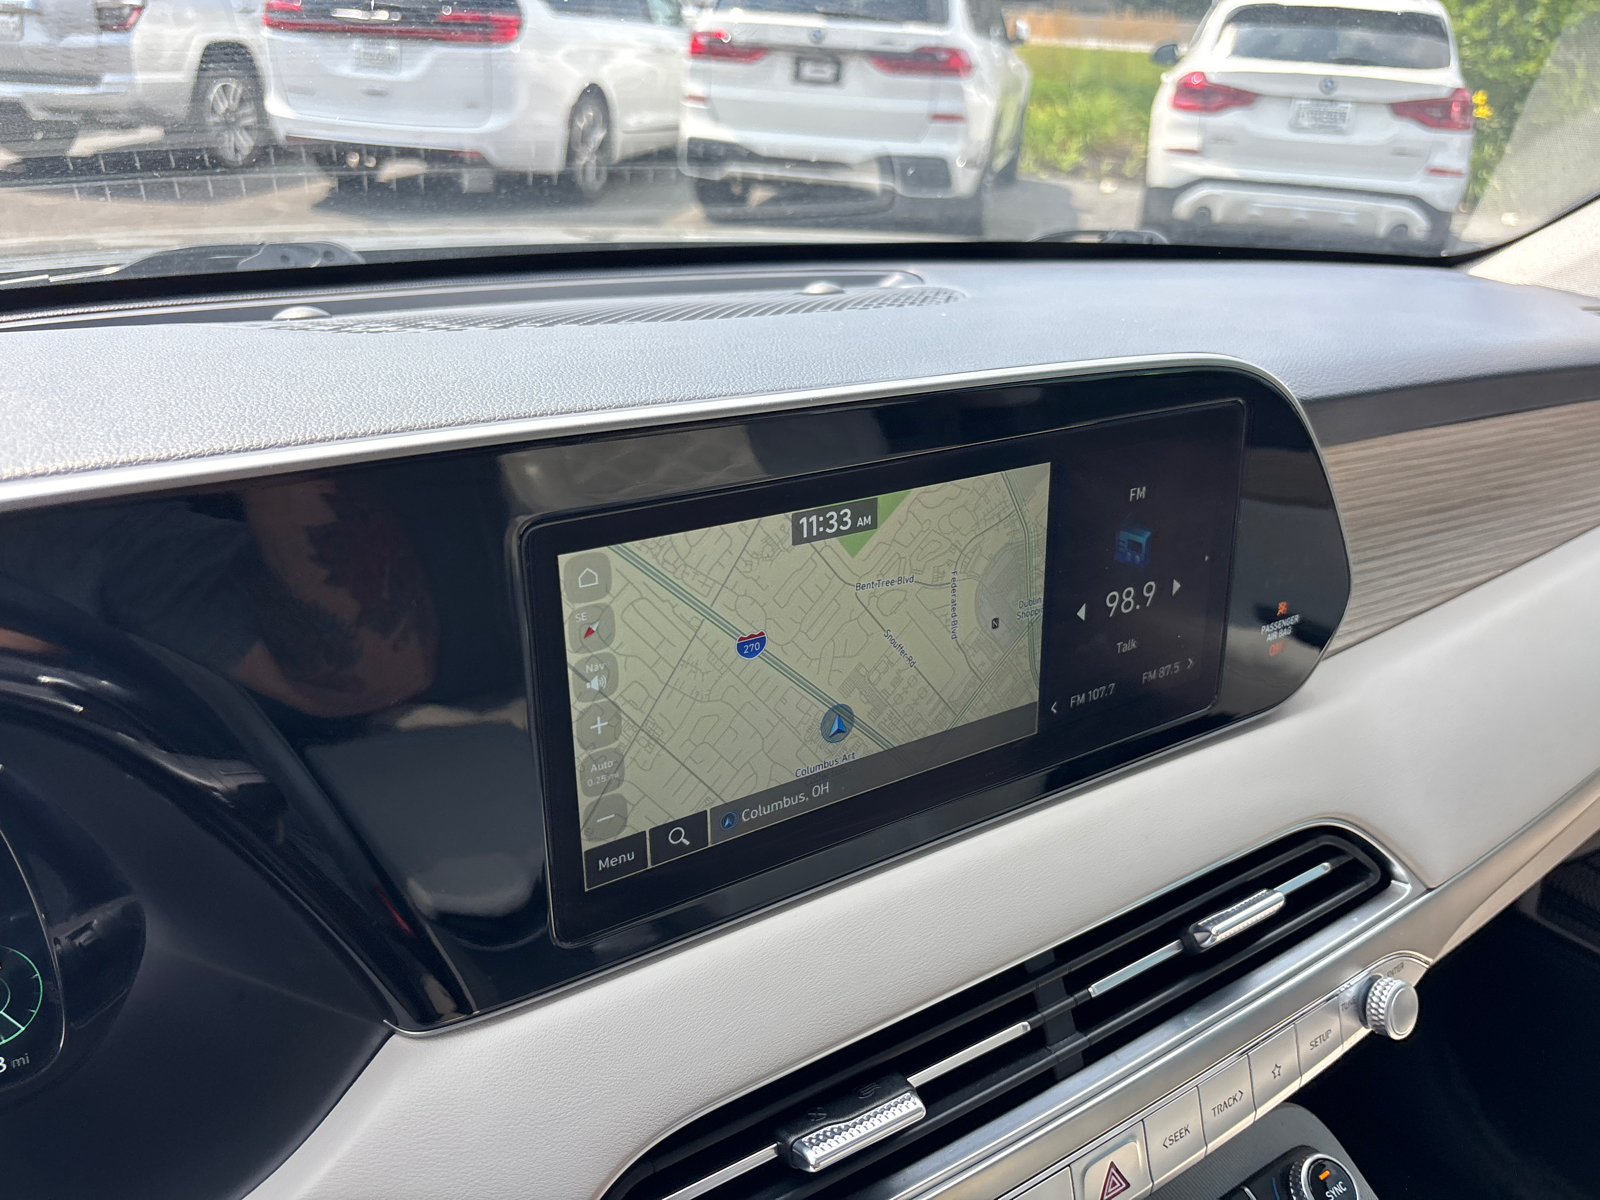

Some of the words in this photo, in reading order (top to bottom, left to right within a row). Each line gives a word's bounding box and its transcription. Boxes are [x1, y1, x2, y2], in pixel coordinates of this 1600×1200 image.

[1129, 486, 1147, 501] FM
[799, 508, 852, 538] 11:33
[857, 515, 872, 527] AM
[855, 579, 875, 592] Bent
[876, 577, 896, 589] Tree
[897, 574, 915, 586] Blvd
[950, 570, 958, 618] Federated
[1105, 580, 1156, 617] 98.9
[575, 612, 588, 622] SE
[1261, 614, 1300, 635] PASSENGER
[950, 619, 958, 640] Blvd
[1266, 630, 1278, 642] AIR
[1278, 626, 1293, 638] BAG
[743, 642, 760, 654] 270
[883, 629, 907, 659] Snouffer
[906, 654, 916, 668] Rd
[1116, 638, 1137, 654] Talk
[585, 663, 605, 674] Nav
[1142, 669, 1157, 684] FM
[1158, 661, 1180, 679] 87.5
[1069, 692, 1086, 708] FM
[1087, 682, 1116, 702] 107.7
[590, 760, 614, 773] Auto
[795, 758, 839, 778] Columbus
[841, 752, 856, 763] Art
[741, 792, 809, 822] Columbus,
[811, 782, 830, 798] OH
[598, 850, 635, 871] Menu
[1386, 961, 1405, 978] ENTER
[1308, 1029, 1333, 1051] SETUP
[12, 1053, 30, 1068] mi
[1211, 1095, 1239, 1118] TRACK
[1167, 1124, 1191, 1147] SEEK
[1325, 1180, 1348, 1200] SYNC
